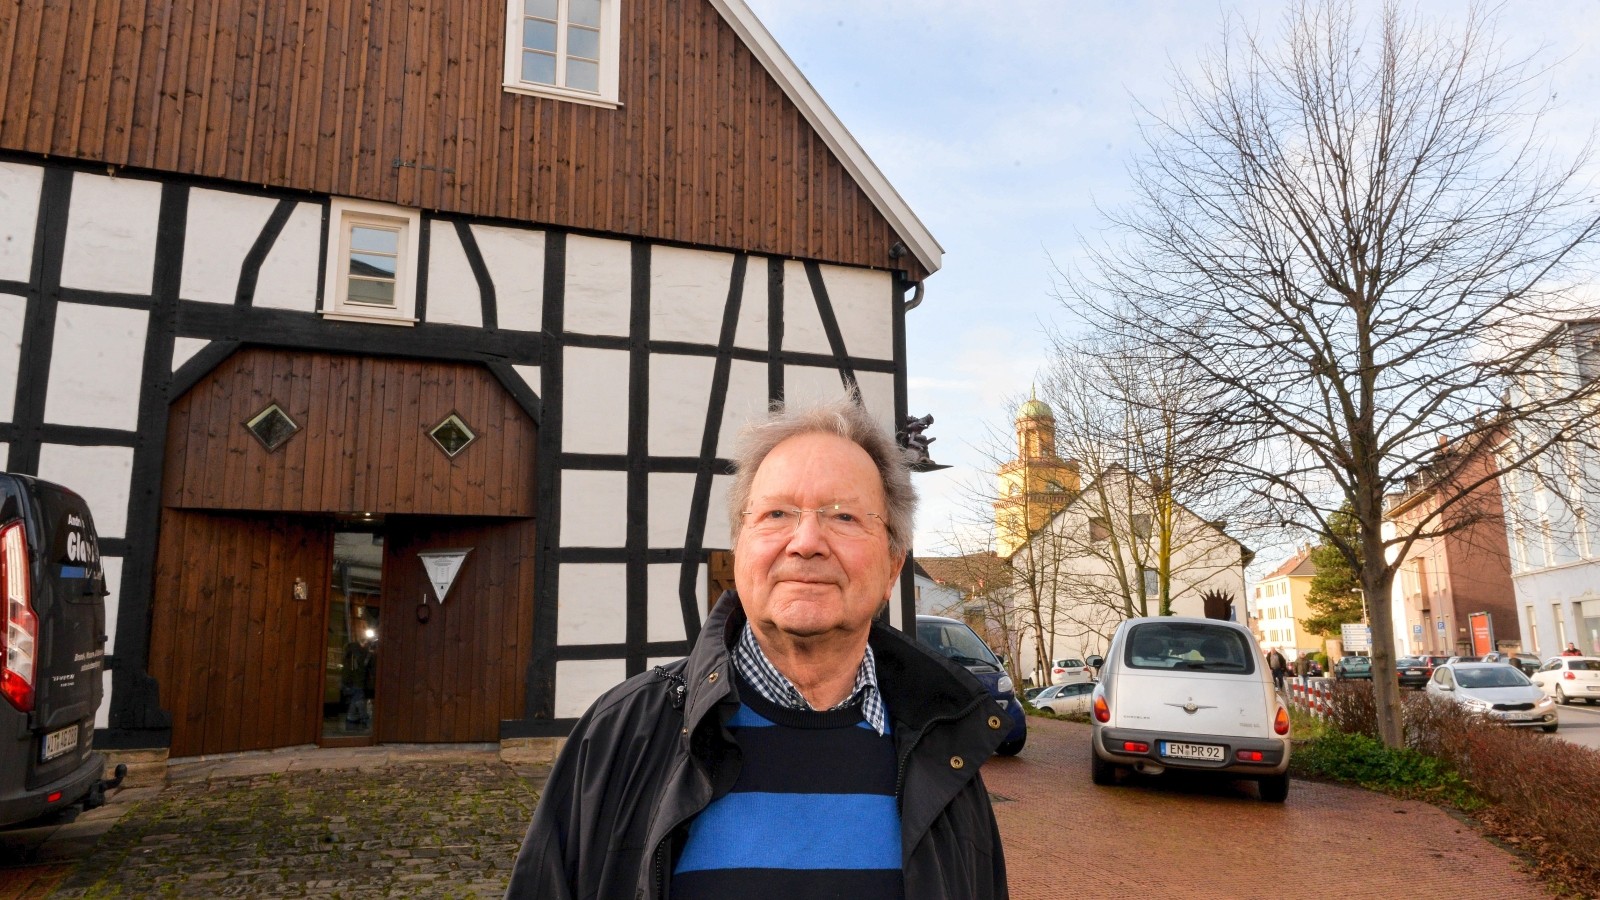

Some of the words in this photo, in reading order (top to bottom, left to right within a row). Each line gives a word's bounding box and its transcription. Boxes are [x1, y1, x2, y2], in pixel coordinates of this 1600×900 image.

[1170, 744, 1184, 755] EN
[1191, 745, 1204, 757] PR
[1206, 746, 1220, 758] 92
